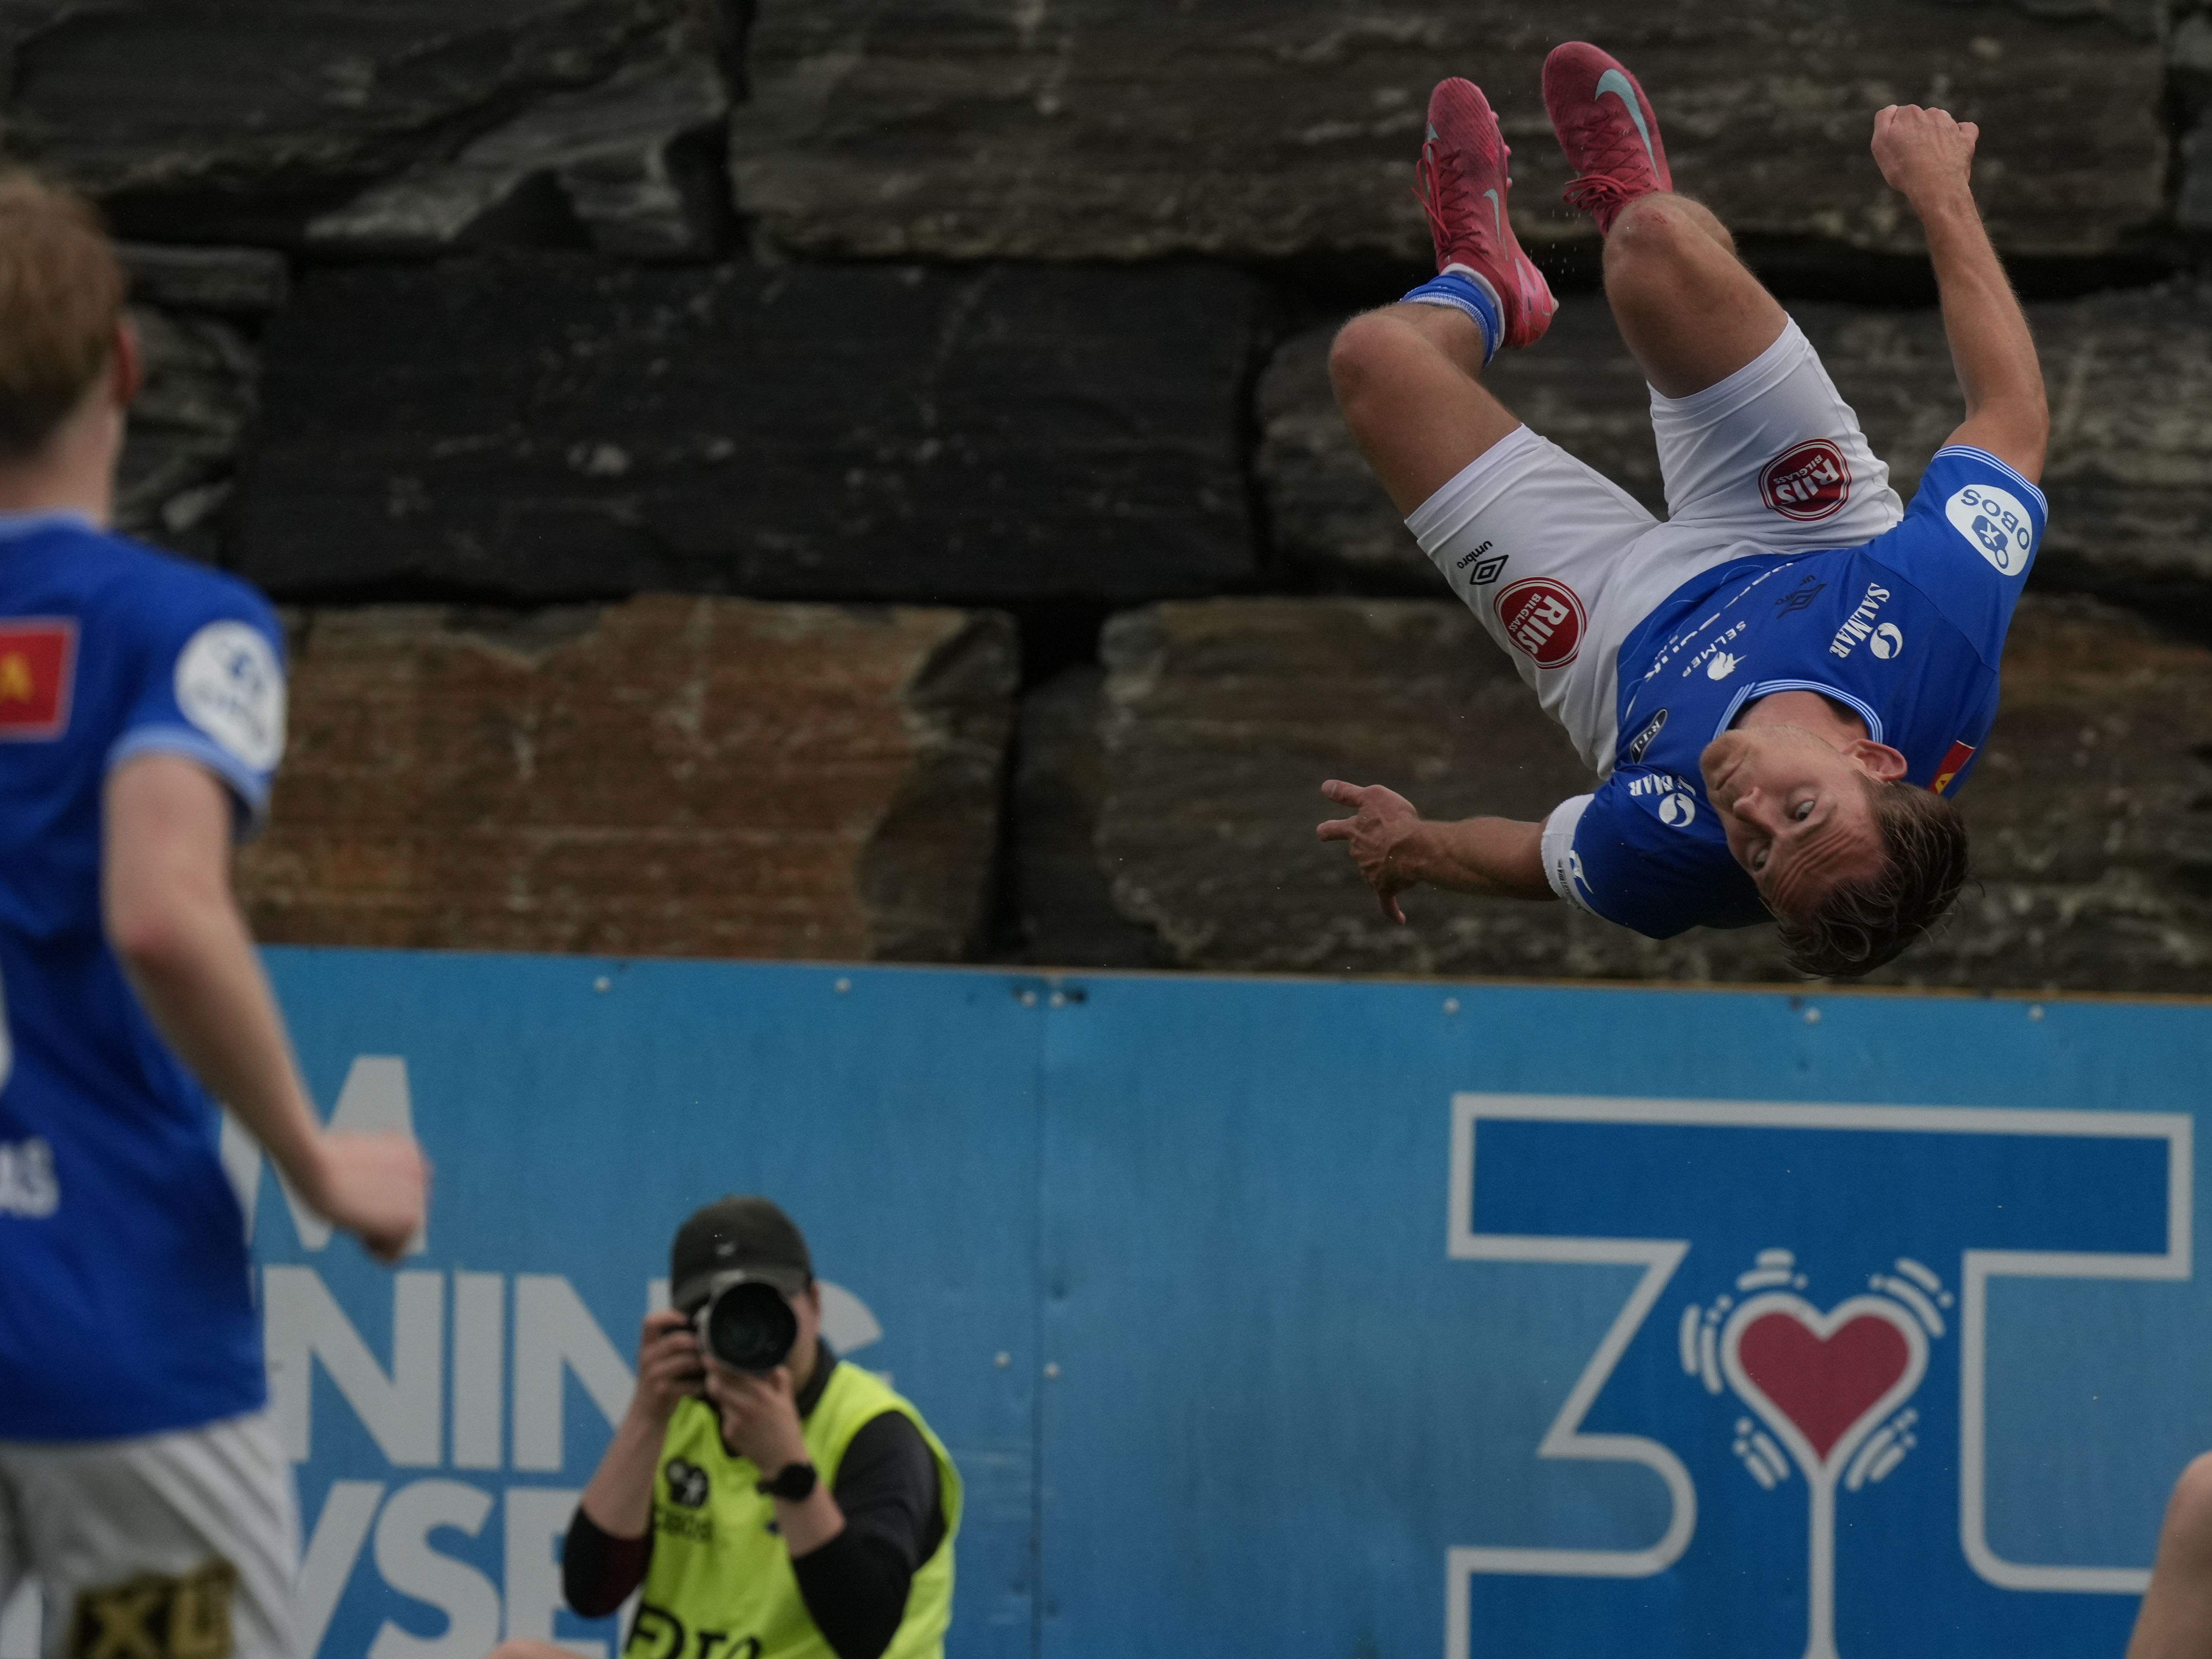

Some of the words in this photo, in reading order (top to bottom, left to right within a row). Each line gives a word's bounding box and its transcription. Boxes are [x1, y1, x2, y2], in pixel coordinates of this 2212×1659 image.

[1774, 454, 1822, 484] BILGLASS
[1775, 458, 1840, 505] RIIS
[1960, 489, 2030, 550] OBOS
[1457, 541, 1493, 569] umbro
[1509, 593, 1542, 632] BILGLASS
[1516, 595, 1570, 654] RIIS
[1829, 583, 1890, 658] SALMAR
